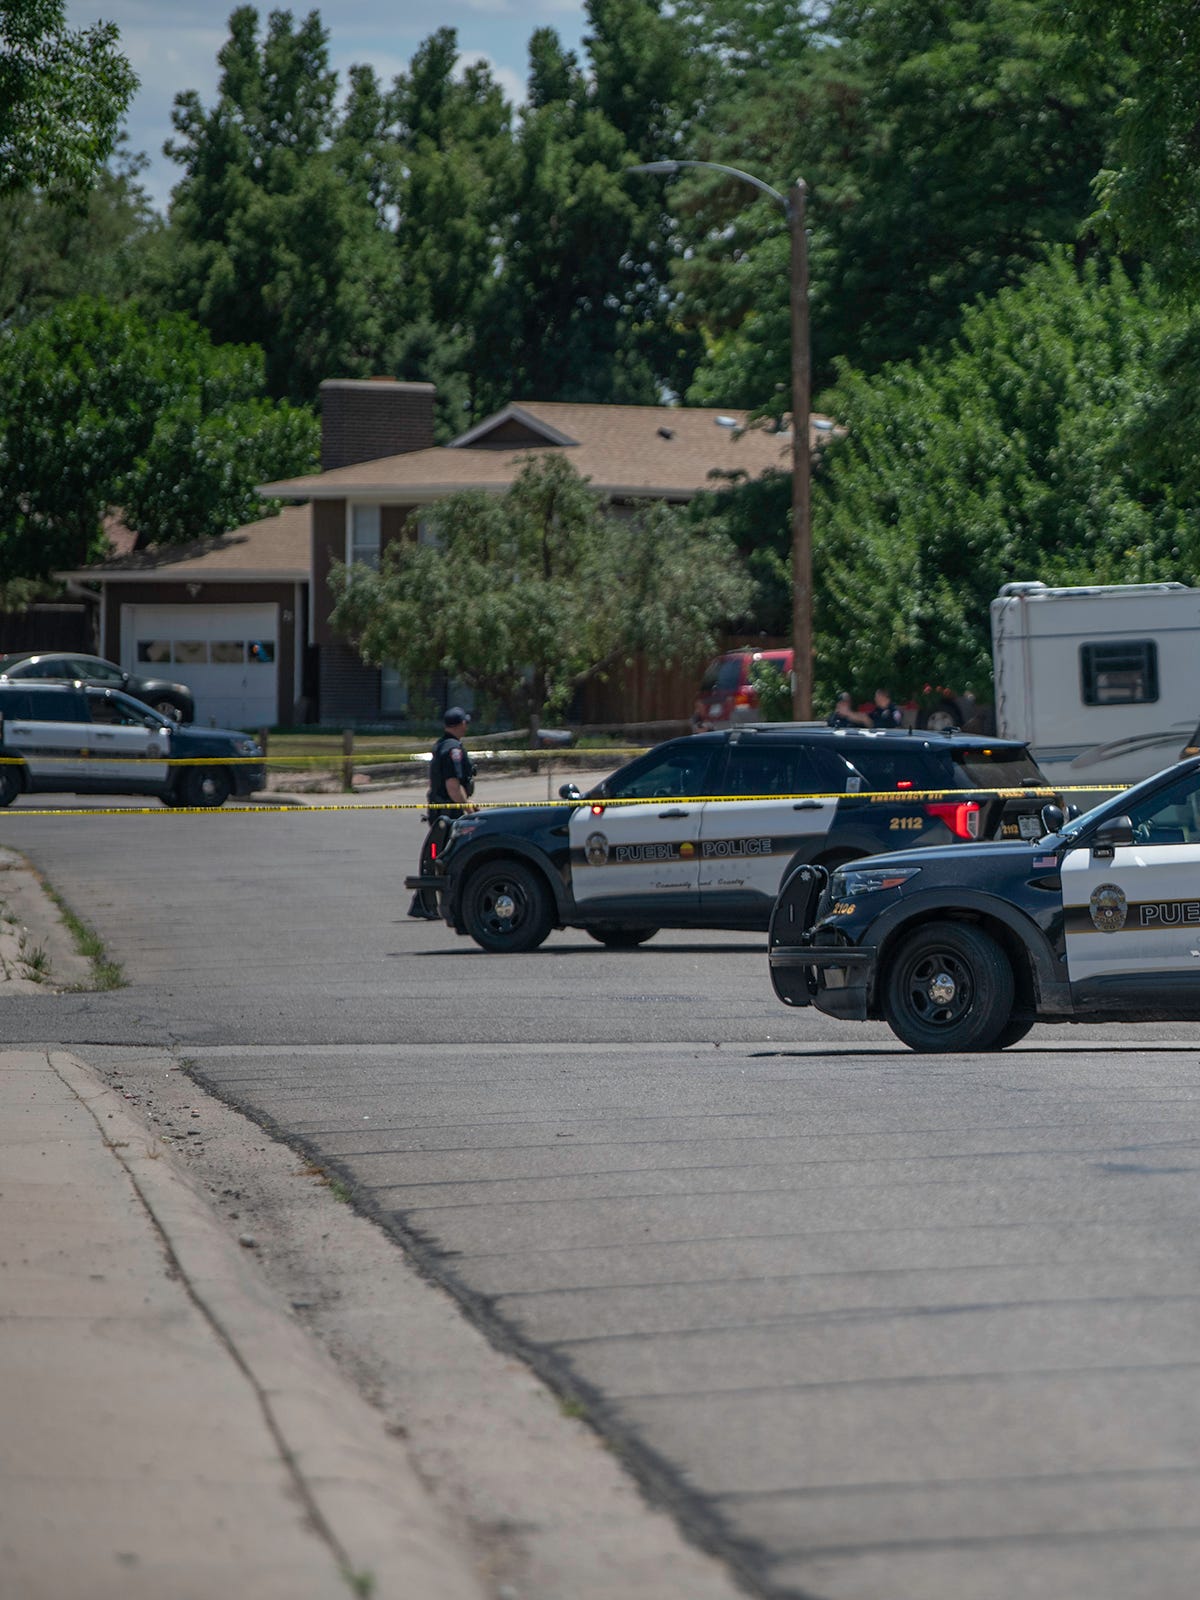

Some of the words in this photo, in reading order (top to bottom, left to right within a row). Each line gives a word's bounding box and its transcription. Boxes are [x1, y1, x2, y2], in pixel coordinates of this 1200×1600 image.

[889, 816, 923, 830] 2112
[1001, 824, 1019, 835] 2112
[702, 839, 772, 857] POLICE
[832, 902, 857, 914] 2106
